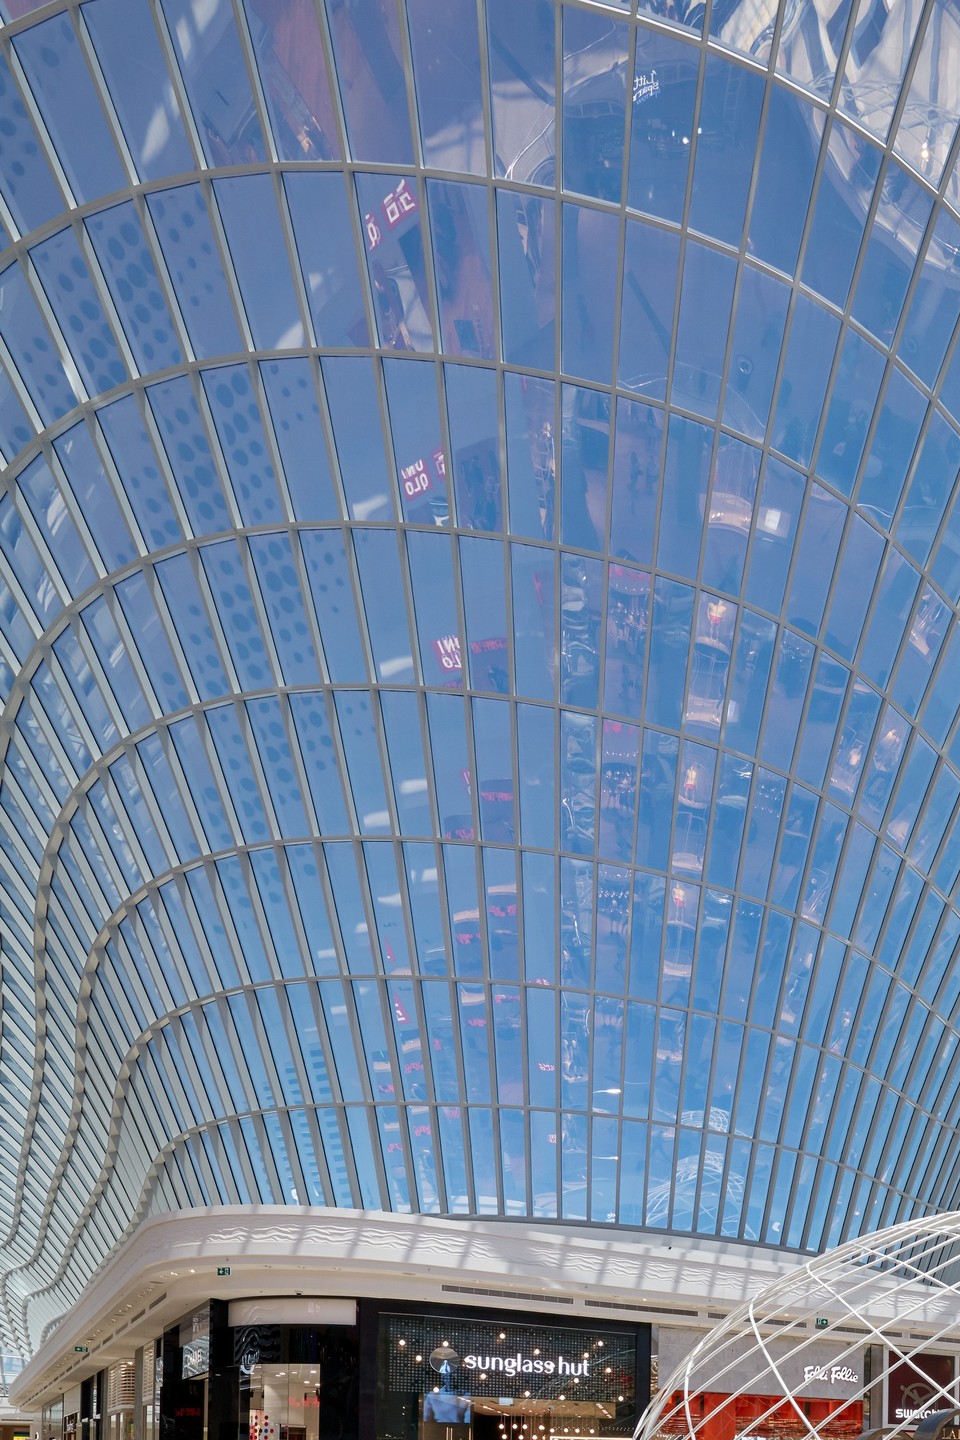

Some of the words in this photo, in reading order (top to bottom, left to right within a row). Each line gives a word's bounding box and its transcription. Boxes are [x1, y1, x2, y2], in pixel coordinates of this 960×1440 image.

[465, 1353, 555, 1377] sunglass
[558, 1356, 590, 1377] hut
[831, 1366, 859, 1384] Follie
